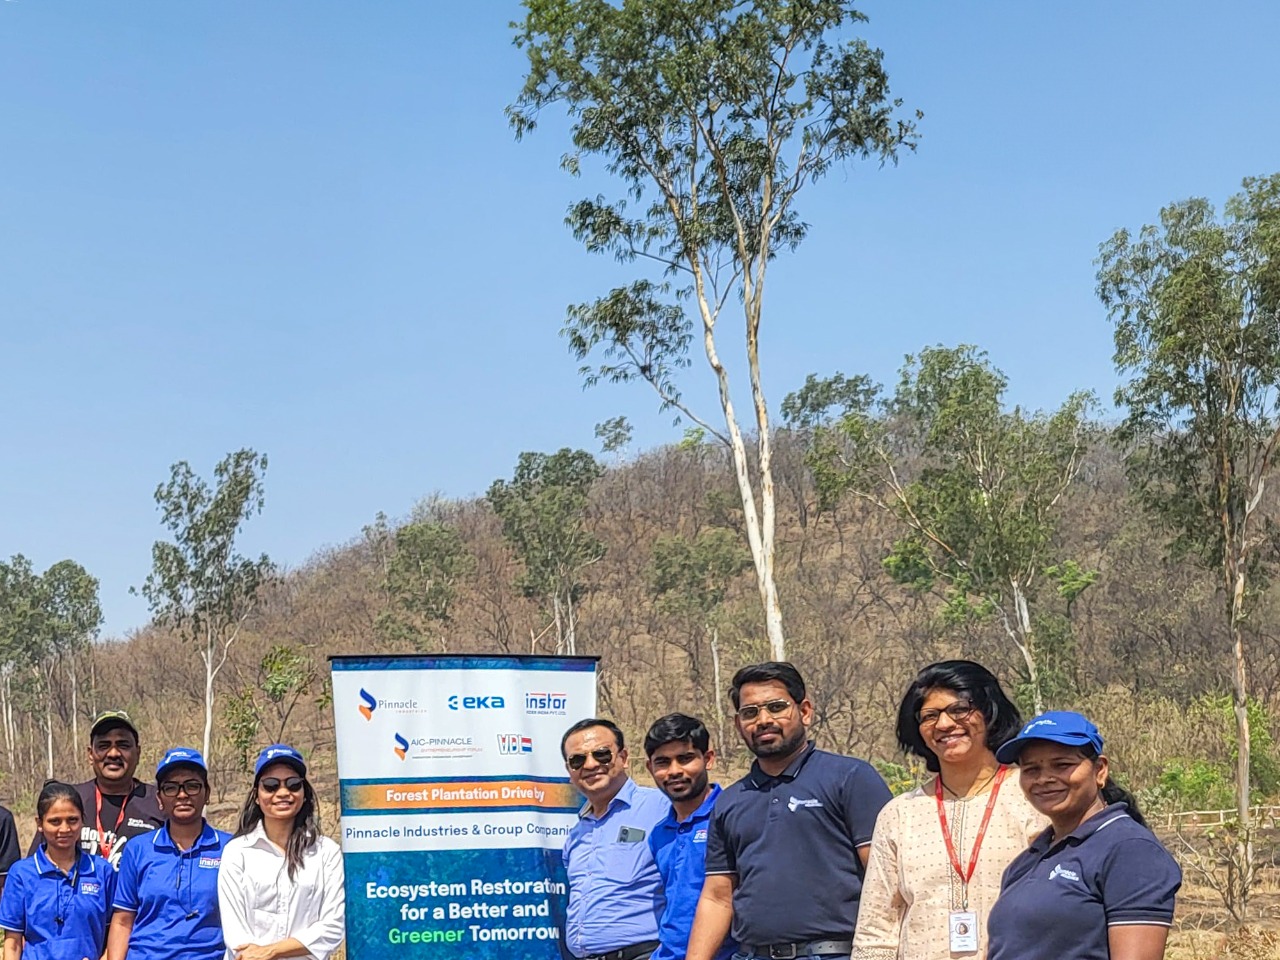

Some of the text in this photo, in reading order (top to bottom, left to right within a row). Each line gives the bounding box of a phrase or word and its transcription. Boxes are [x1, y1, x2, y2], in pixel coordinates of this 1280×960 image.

[378, 699, 418, 709] Pinnacle
[463, 696, 505, 709] eka
[525, 693, 567, 709] instor
[411, 737, 472, 746] AIC-PINNACLE
[497, 734, 531, 755] VDL
[386, 786, 545, 802] Forest Plantation Drive by
[346, 823, 572, 839] Pinnacle Industries & Group Compani
[366, 878, 566, 901] Ecosystem Restoration
[400, 900, 549, 920] for a Better and
[388, 925, 560, 944] Greener Tomorrow
